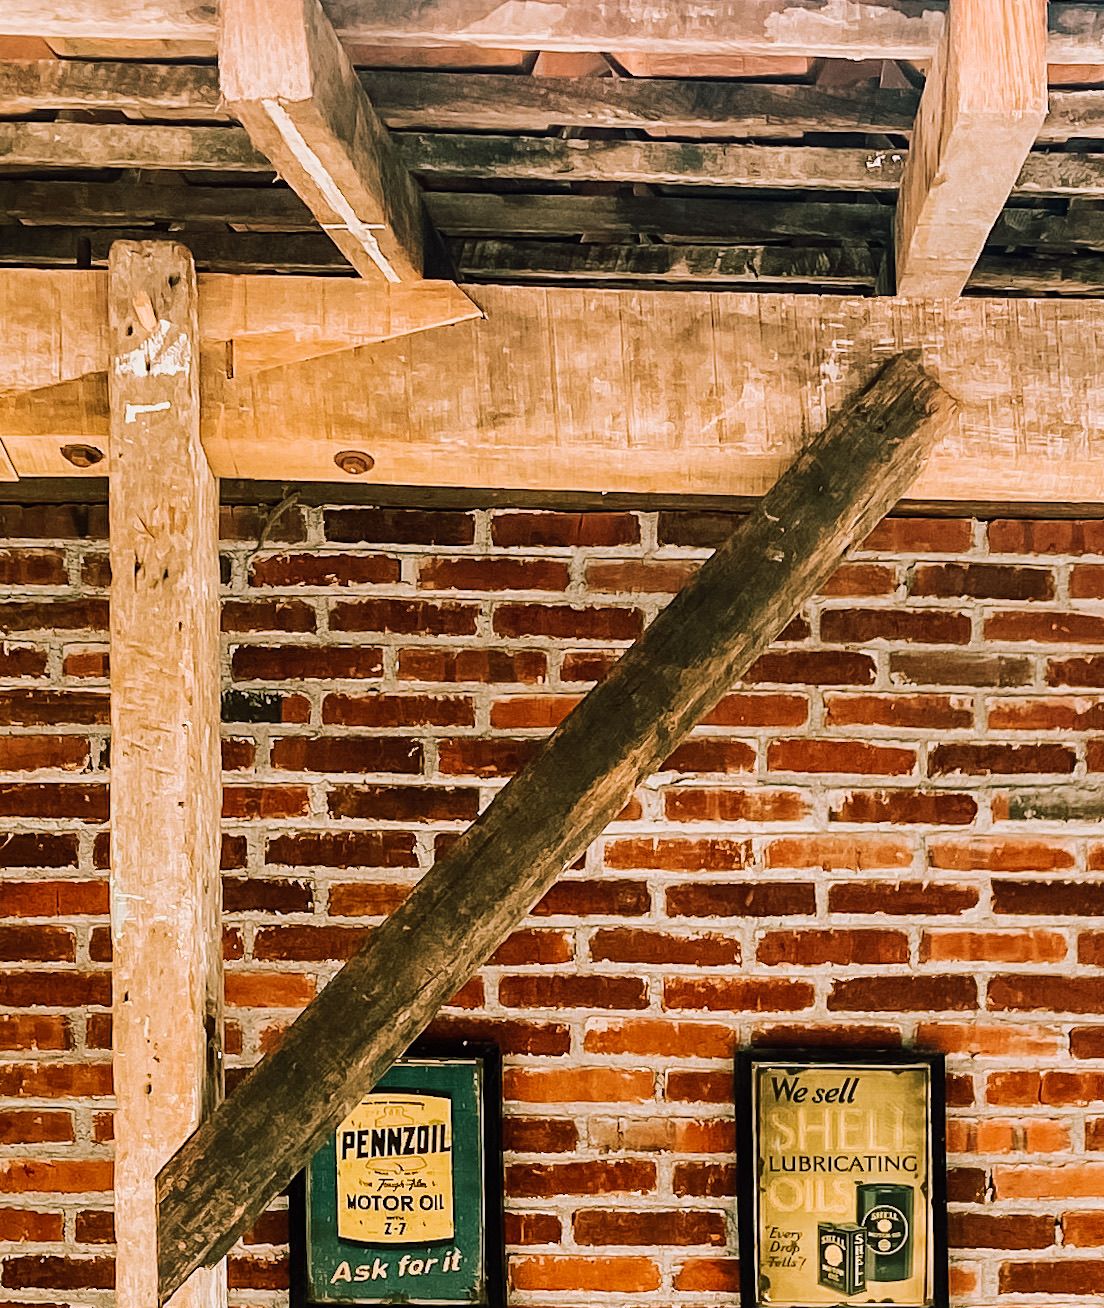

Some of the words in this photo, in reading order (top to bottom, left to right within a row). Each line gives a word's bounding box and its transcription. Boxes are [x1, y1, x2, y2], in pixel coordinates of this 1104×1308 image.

[771, 1077, 808, 1103] We
[812, 1077, 860, 1104] sell
[342, 1124, 451, 1160] PENNZOIL
[769, 1106, 916, 1151] SHELL
[769, 1156, 918, 1173] LUBRICATING
[346, 1194, 414, 1211] MOTOR
[419, 1194, 444, 1211] OIL
[769, 1175, 851, 1215] OILS
[384, 1222, 407, 1235] Z-7
[330, 1258, 389, 1284] Ask
[398, 1254, 438, 1277] for
[442, 1246, 463, 1273] it
